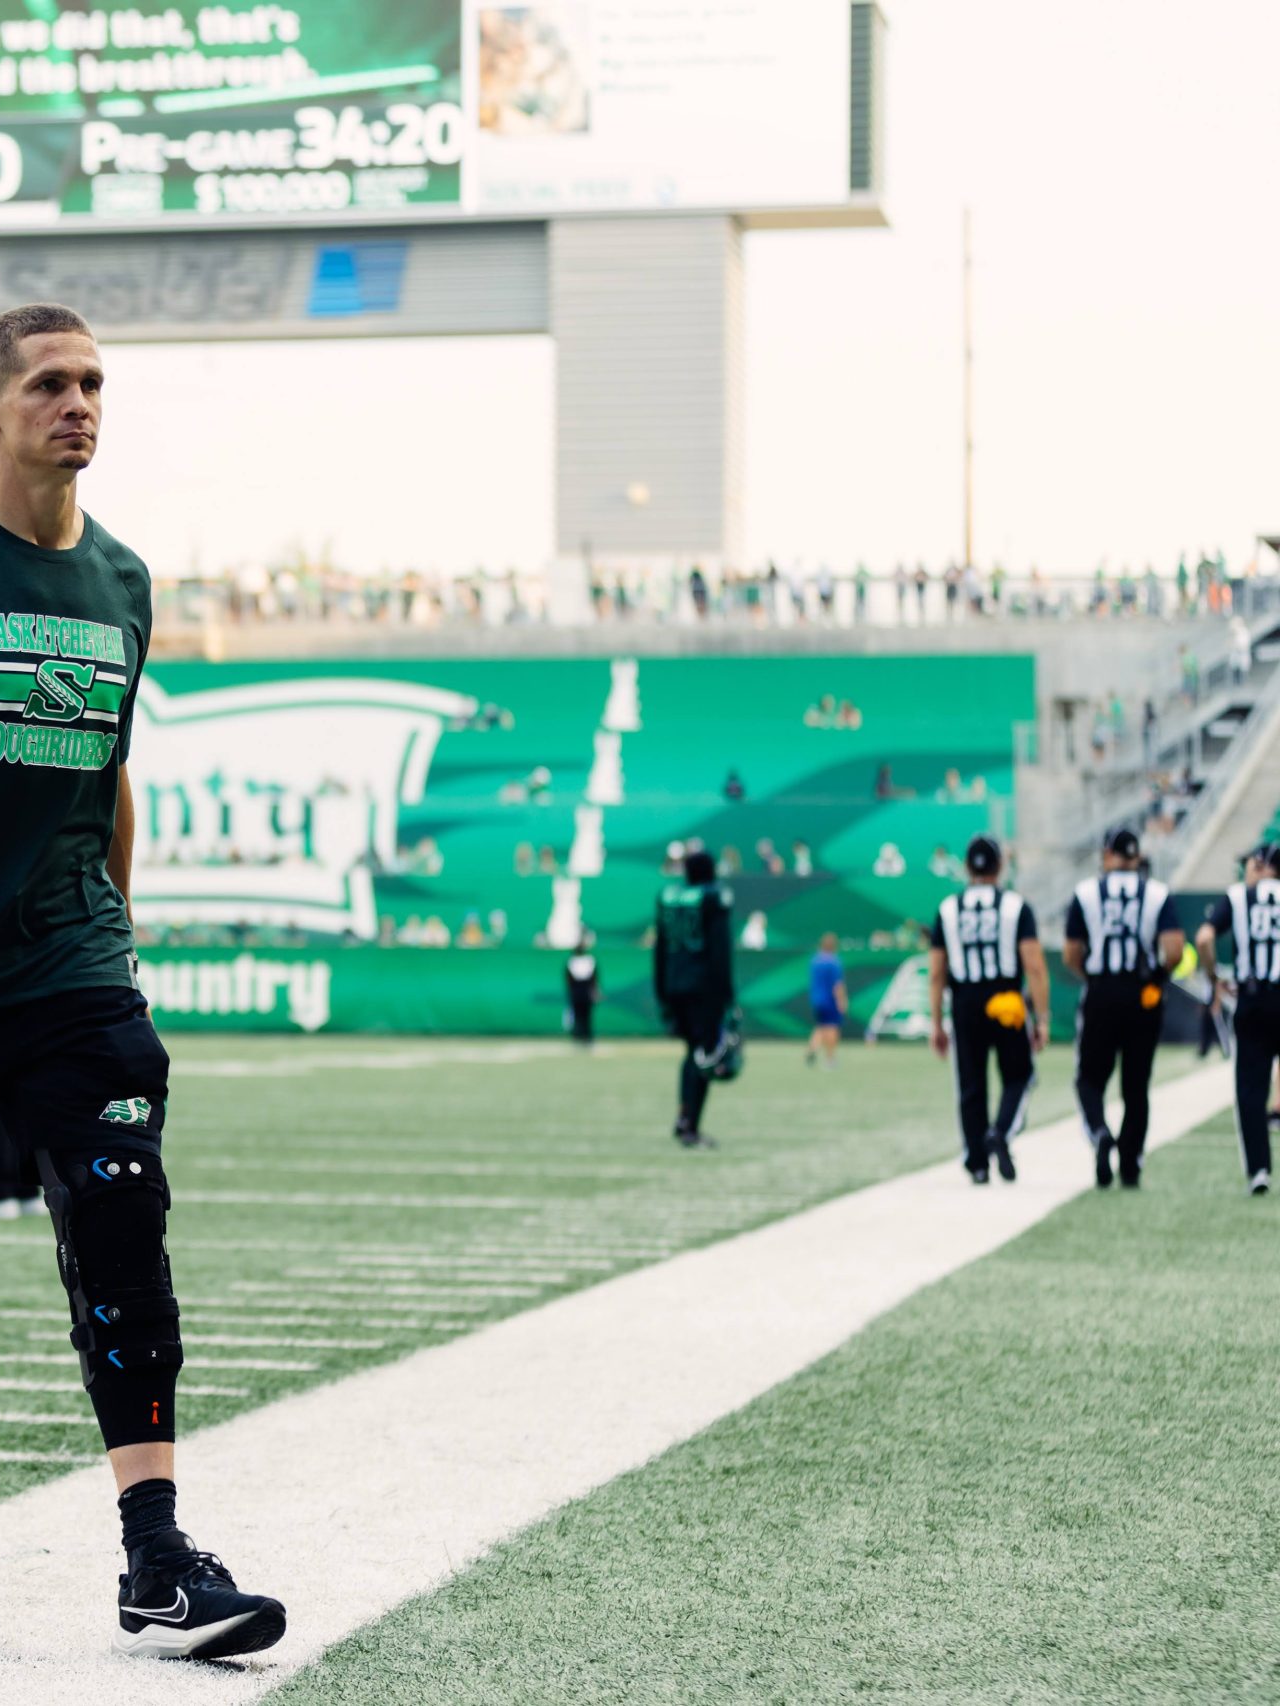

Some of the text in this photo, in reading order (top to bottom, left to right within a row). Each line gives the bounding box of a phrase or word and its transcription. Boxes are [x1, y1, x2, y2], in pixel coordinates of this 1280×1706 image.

[0, 20, 50, 51] we
[294, 103, 464, 170] 34:20
[151, 1350, 157, 1358] 2
